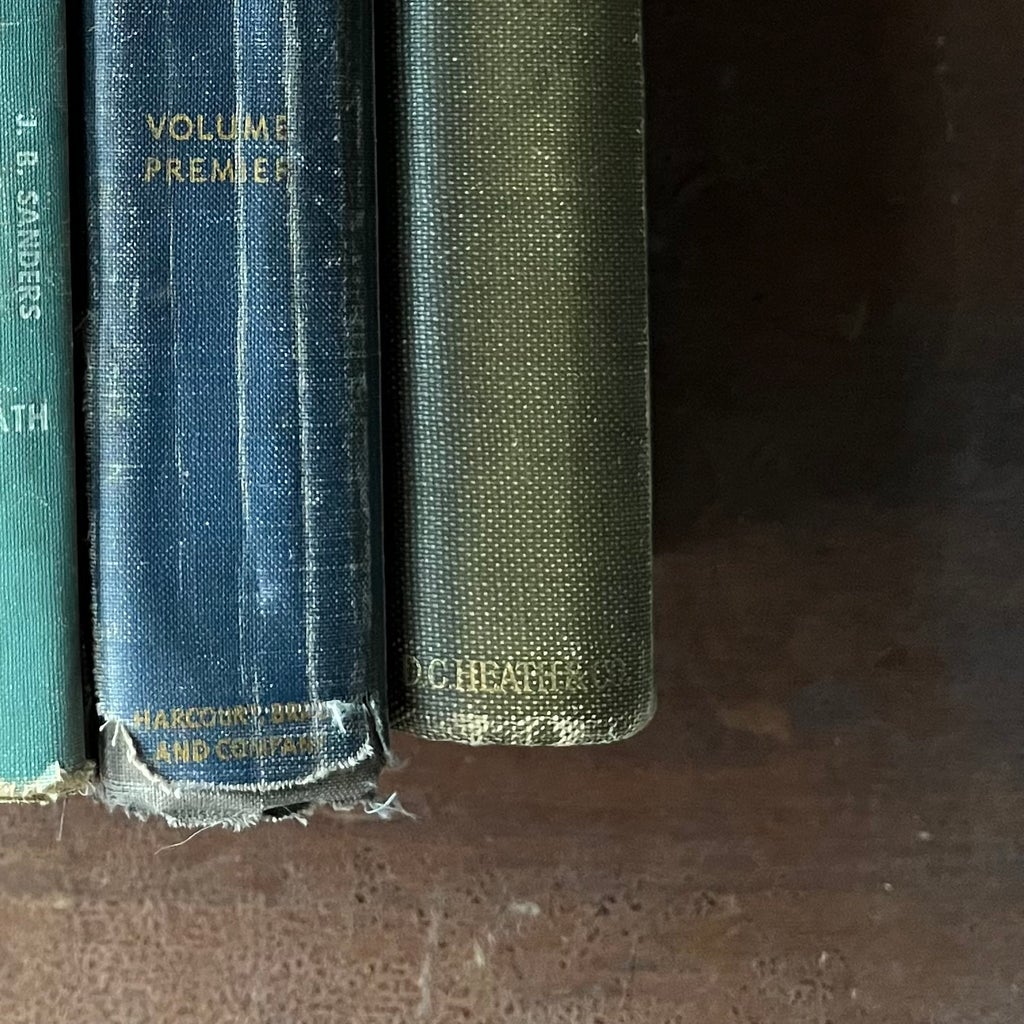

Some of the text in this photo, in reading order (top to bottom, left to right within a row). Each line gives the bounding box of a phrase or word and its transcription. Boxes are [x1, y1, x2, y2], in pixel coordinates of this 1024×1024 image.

[145, 111, 292, 142] VOLUME
[16, 189, 42, 322] SANDERS
[155, 738, 212, 765] AND
